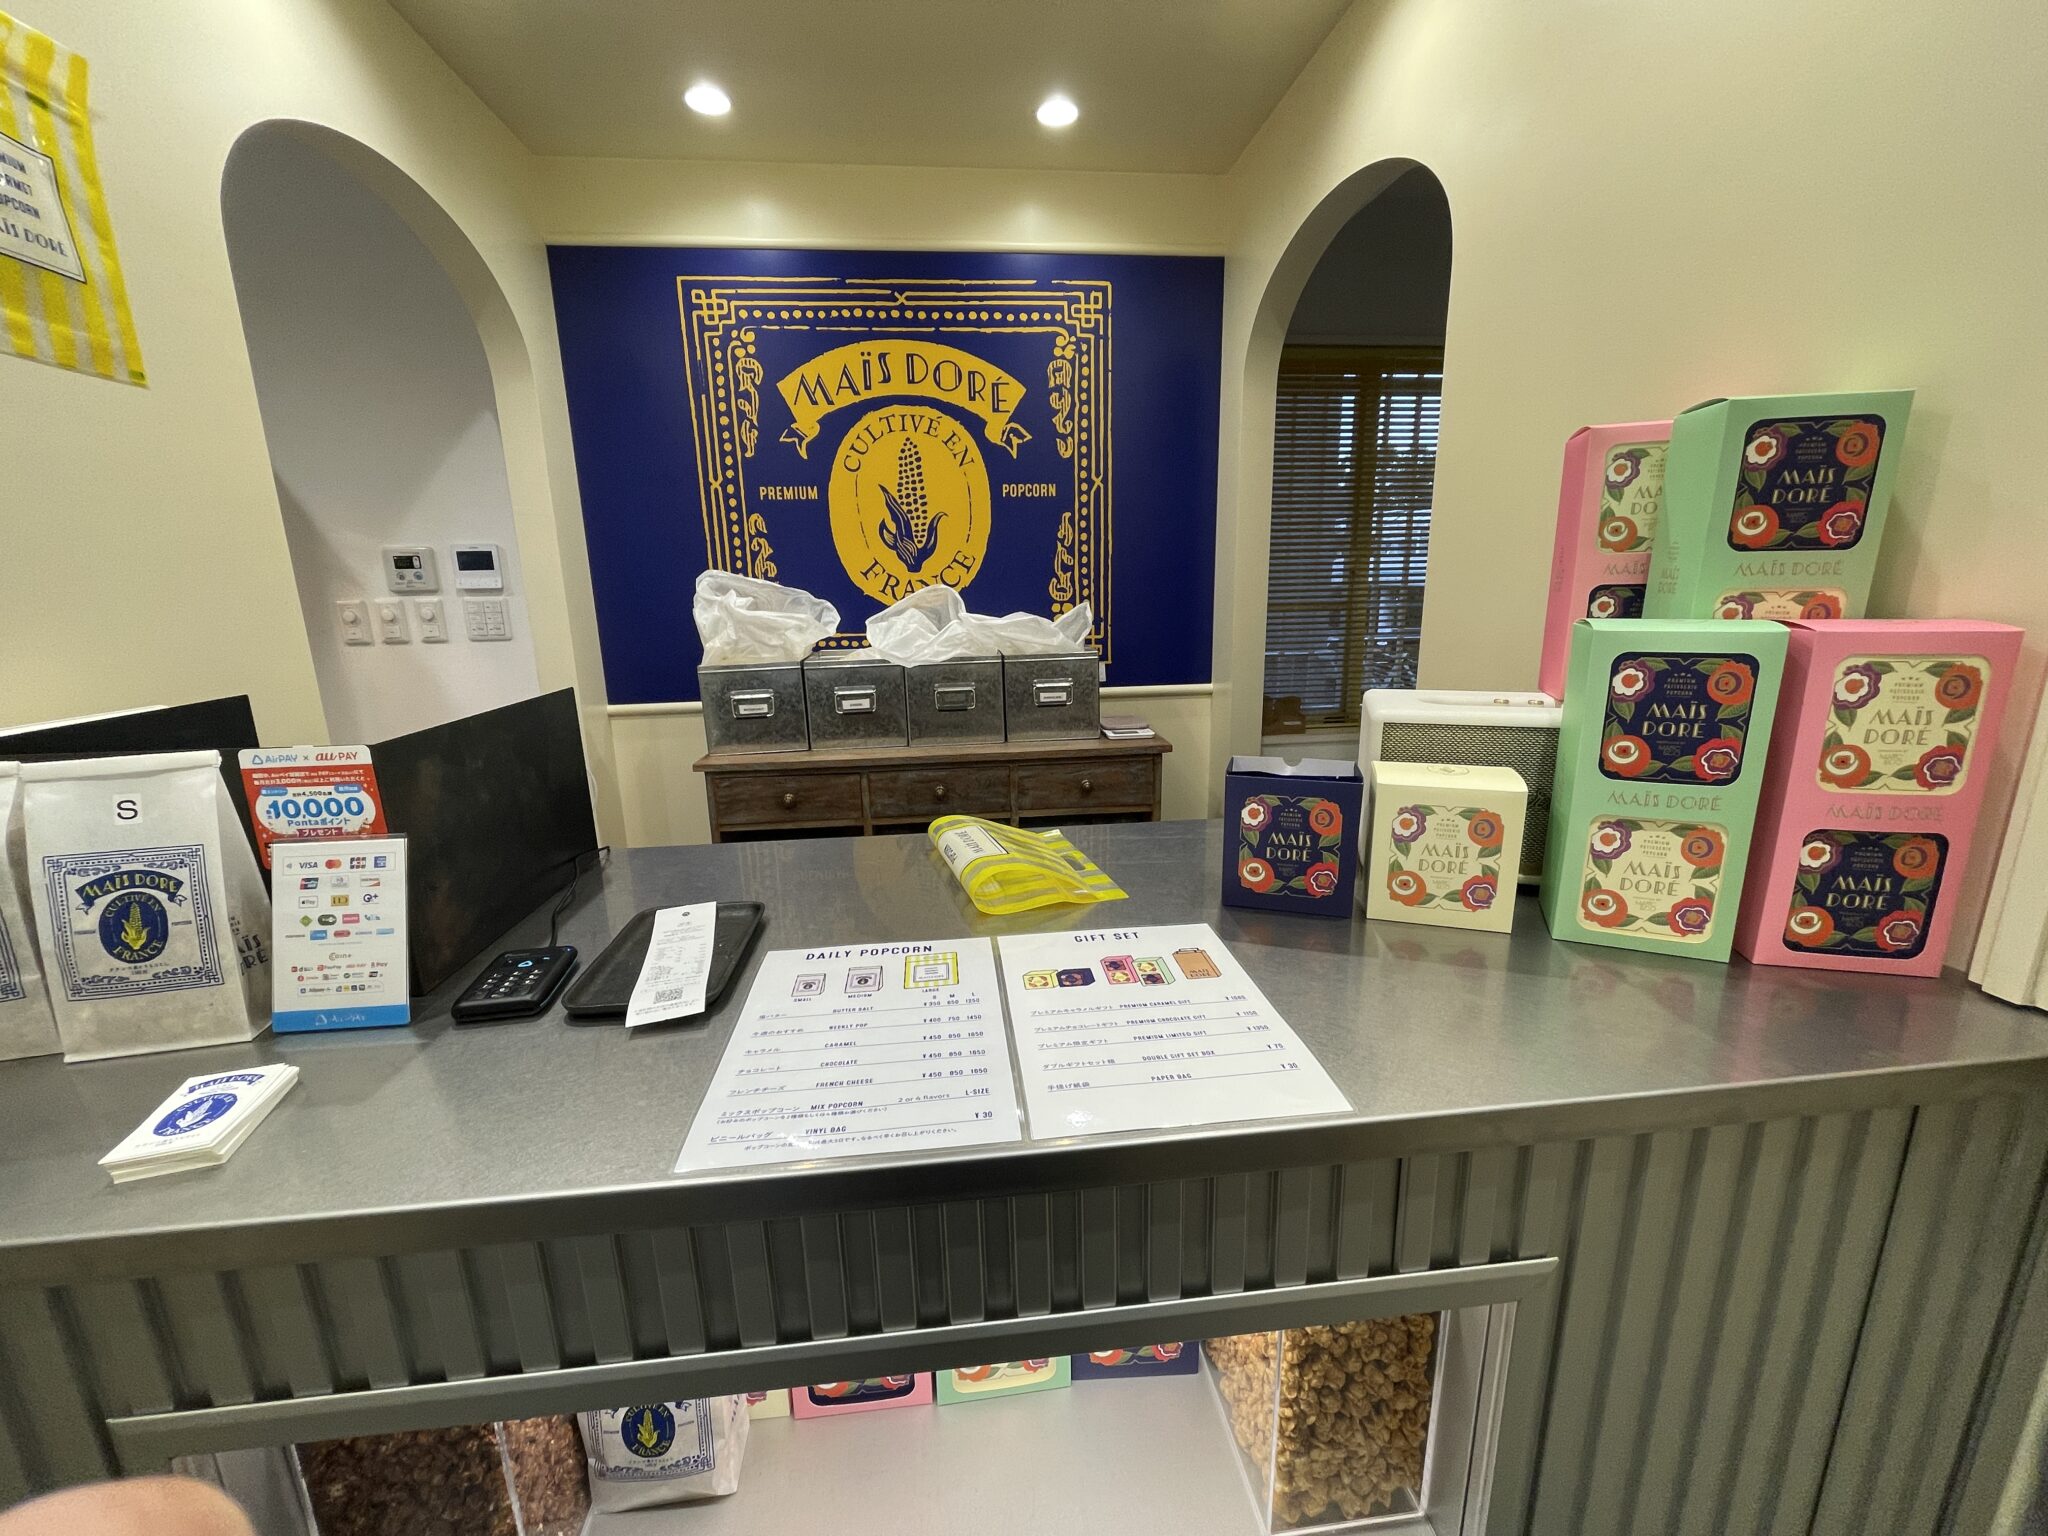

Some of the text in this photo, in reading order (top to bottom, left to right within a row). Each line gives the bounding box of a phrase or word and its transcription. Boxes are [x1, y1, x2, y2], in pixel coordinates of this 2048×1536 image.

[794, 352, 1011, 414] MAÏS DORÉ
[843, 413, 975, 473] CULTIVÉ EN
[1777, 464, 1838, 485] MAÏS
[759, 484, 818, 501] PREMIUM
[1002, 482, 1057, 498] POPCORN
[1771, 485, 1832, 504] DORÉ
[1733, 559, 1843, 577] MAÏS DORÉ
[1646, 700, 1708, 720] MAÏS
[1868, 706, 1935, 726] MAÏS
[1641, 720, 1707, 738] DORÉ
[1863, 727, 1932, 746] DORÉ
[338, 751, 358, 761] PAY
[116, 799, 139, 820] S
[268, 796, 365, 819] 10,000
[1607, 790, 1723, 811] MAÏS DORÉ
[287, 817, 351, 827] Pontaポイント
[1268, 831, 1312, 847] MAÏS
[1266, 847, 1312, 862] DORÉ
[1421, 842, 1469, 858] MAÏS
[299, 861, 318, 869] VISA
[1418, 858, 1469, 875] DORÉ
[1623, 861, 1682, 879] MAÏS
[83, 874, 130, 897] MAÏS
[1619, 877, 1681, 896] DORÉ
[1831, 873, 1892, 892] MAÏS
[1825, 892, 1891, 910] DORÉ
[1074, 931, 1140, 943] GIFT SET
[113, 939, 164, 960] FRANCE
[806, 945, 932, 960] DAILY POPCORN
[815, 1080, 844, 1088] FRENCH
[846, 1078, 874, 1086] CHEESE
[827, 1101, 864, 1109] POPCORN
[923, 1093, 950, 1101] flavors
[965, 1087, 990, 1096] L-SIZE
[805, 1127, 827, 1135] VINYL
[982, 1110, 993, 1118] 30
